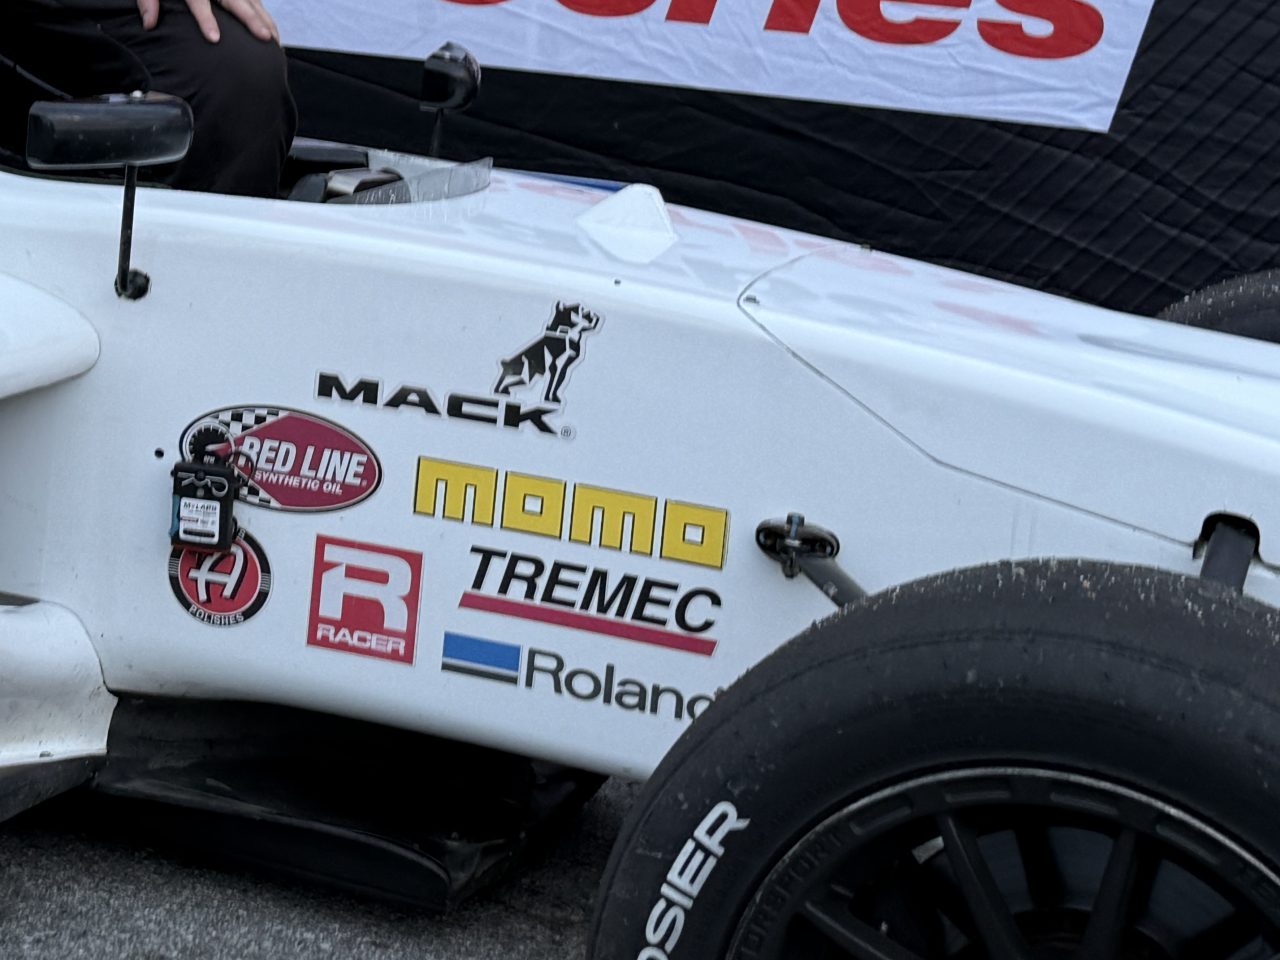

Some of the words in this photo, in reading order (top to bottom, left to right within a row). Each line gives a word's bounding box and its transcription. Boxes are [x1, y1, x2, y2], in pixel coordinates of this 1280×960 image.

[317, 372, 561, 436] MACK
[237, 436, 297, 474] RED
[300, 445, 368, 487] LINE
[254, 470, 320, 492] SYNTHETIC
[322, 480, 343, 496] OIL
[468, 545, 722, 634] TREMEC
[189, 604, 245, 626] POLISHES
[316, 623, 406, 656] RACER
